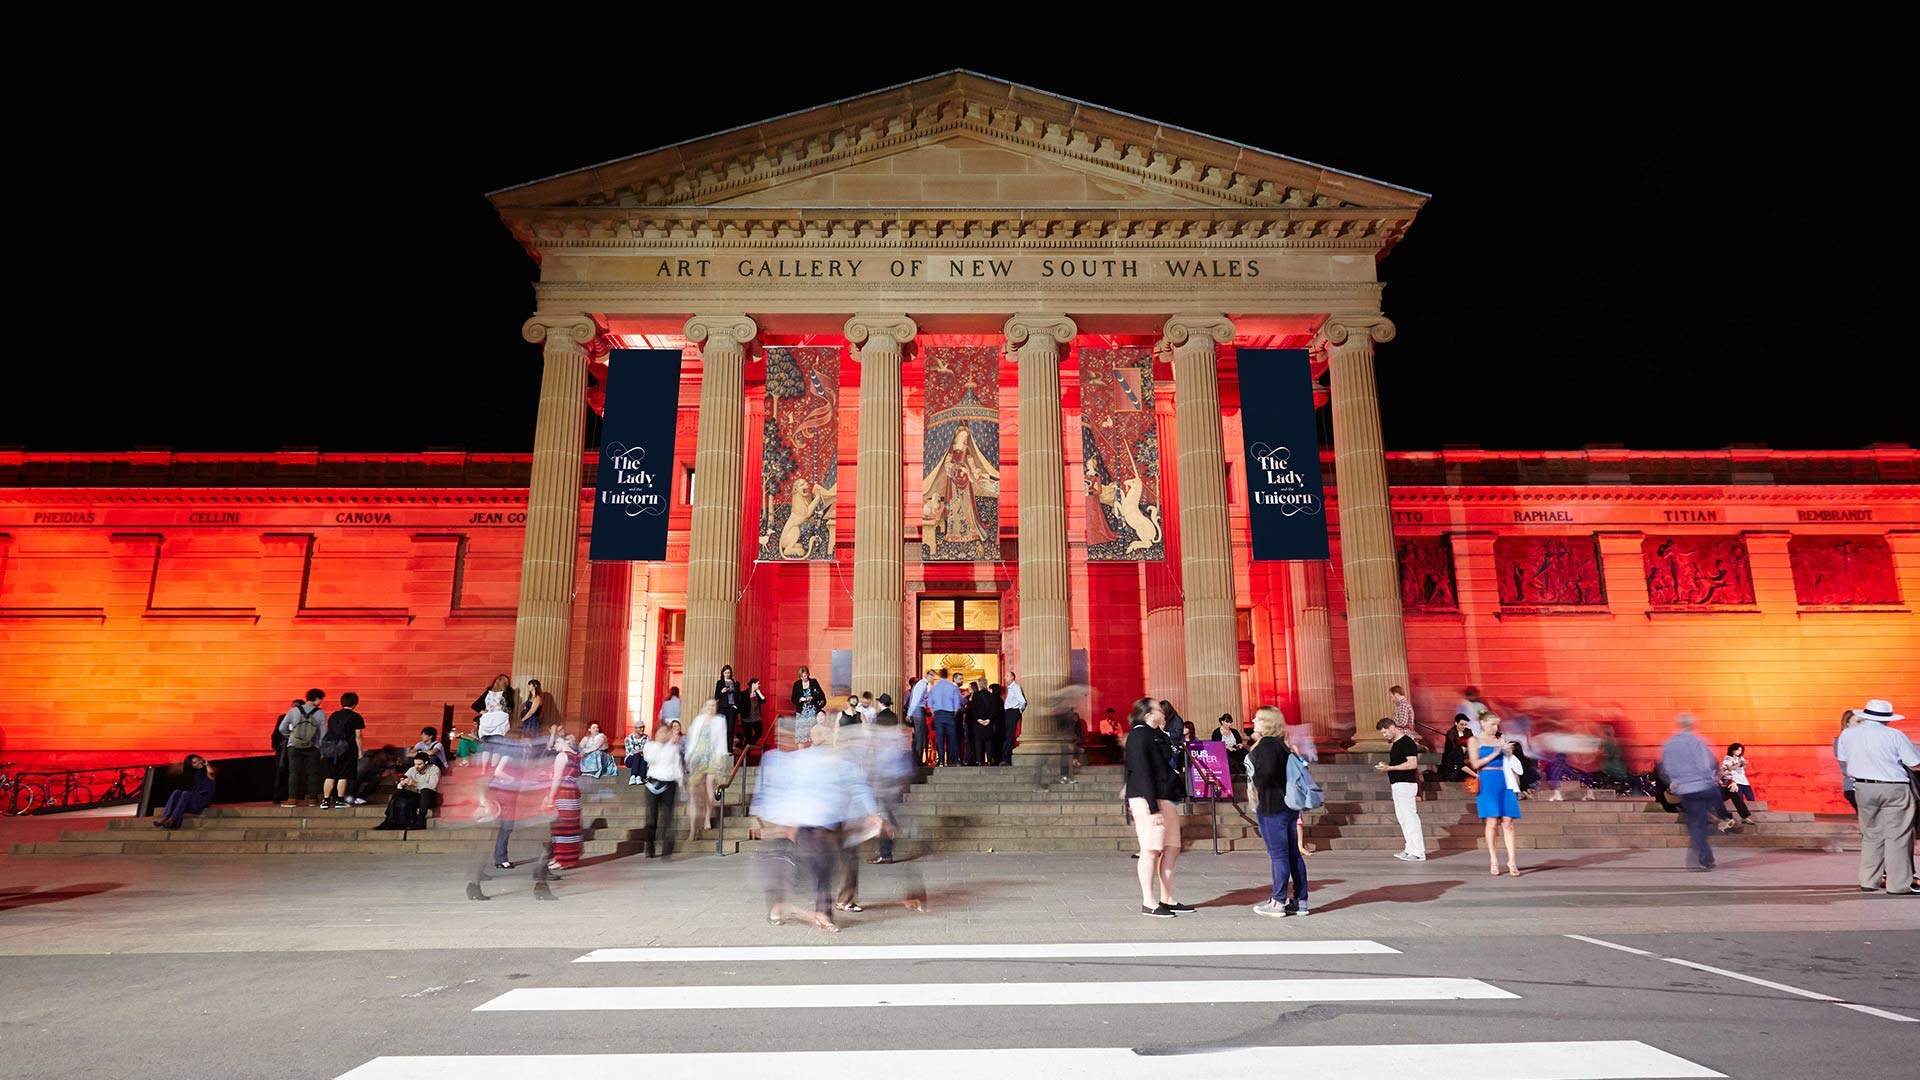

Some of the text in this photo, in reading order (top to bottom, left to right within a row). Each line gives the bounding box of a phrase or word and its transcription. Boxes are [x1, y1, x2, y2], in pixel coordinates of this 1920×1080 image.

[657, 260, 1260, 277] ART GALLERY OF NEW SOUTH WALES
[611, 456, 640, 470] The
[1258, 456, 1288, 470] The
[617, 470, 656, 488] Lady
[1267, 470, 1304, 488] Lady
[602, 491, 658, 504] Unicorn
[1255, 491, 1312, 505] Unicorn
[33, 512, 96, 524] PHEIDIAS
[189, 512, 239, 524] CELLINI
[336, 512, 392, 524] CANOVA
[469, 512, 528, 524] JEAN GO
[1394, 511, 1423, 523] TTO
[1514, 511, 1573, 522] RAPHAEL
[1664, 510, 1717, 522] TITIAN
[1797, 510, 1873, 521] REMBRANDT
